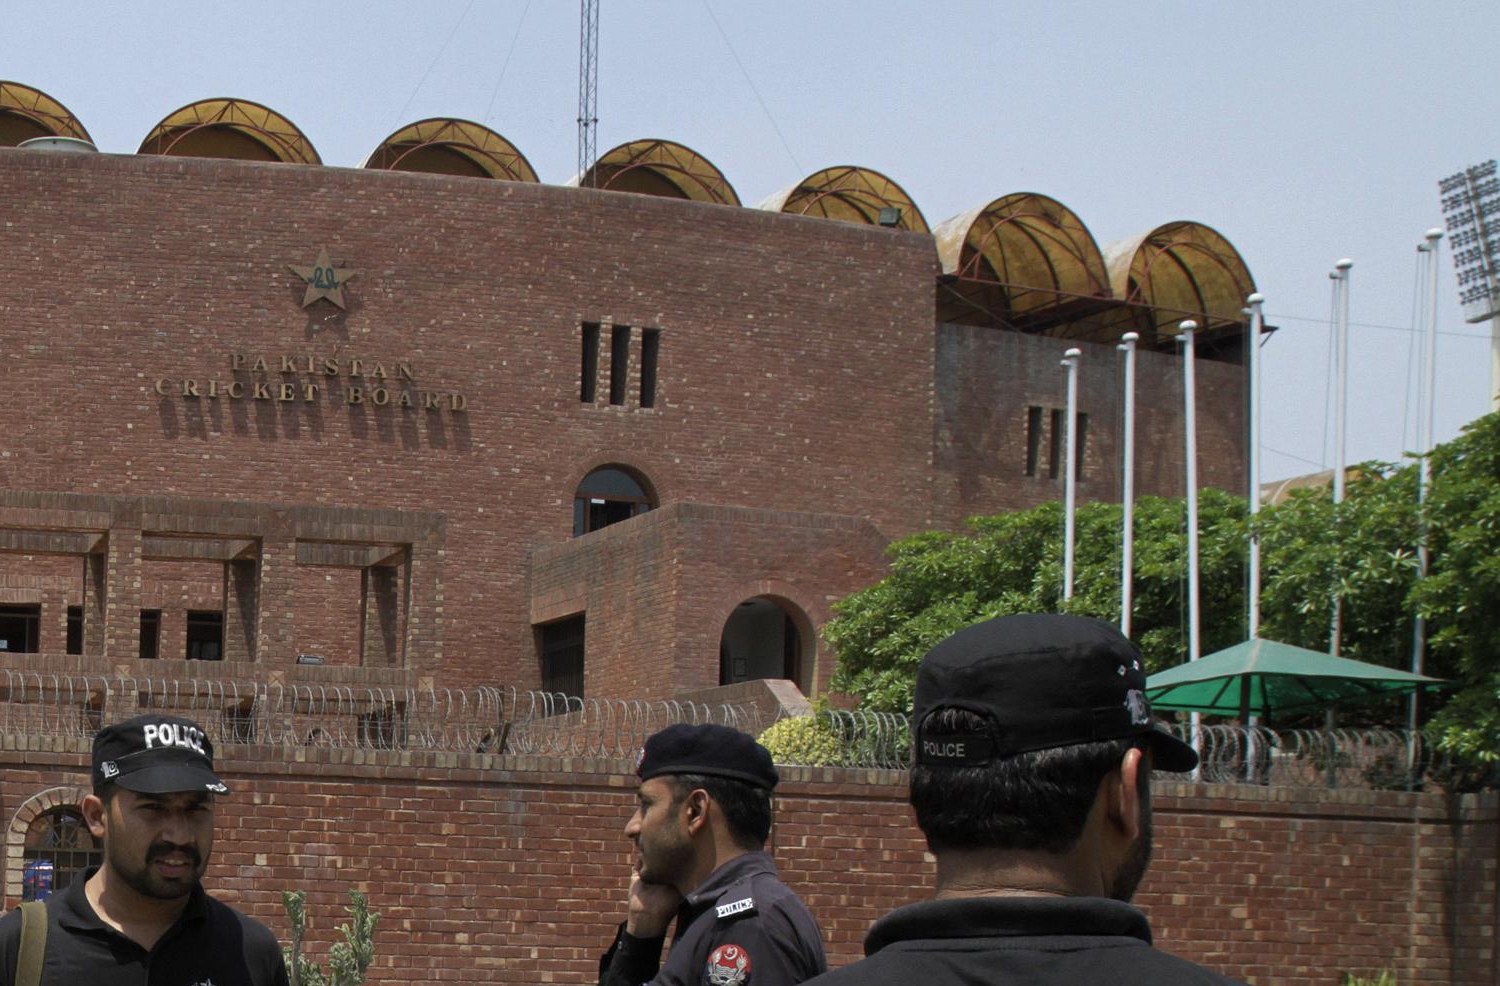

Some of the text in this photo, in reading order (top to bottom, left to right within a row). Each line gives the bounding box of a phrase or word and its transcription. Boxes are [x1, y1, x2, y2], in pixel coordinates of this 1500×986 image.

[229, 353, 415, 382] PAKISTAN
[155, 377, 468, 411] CRICKET BOARD
[143, 723, 206, 755] POLICE
[923, 740, 966, 757] POLICE
